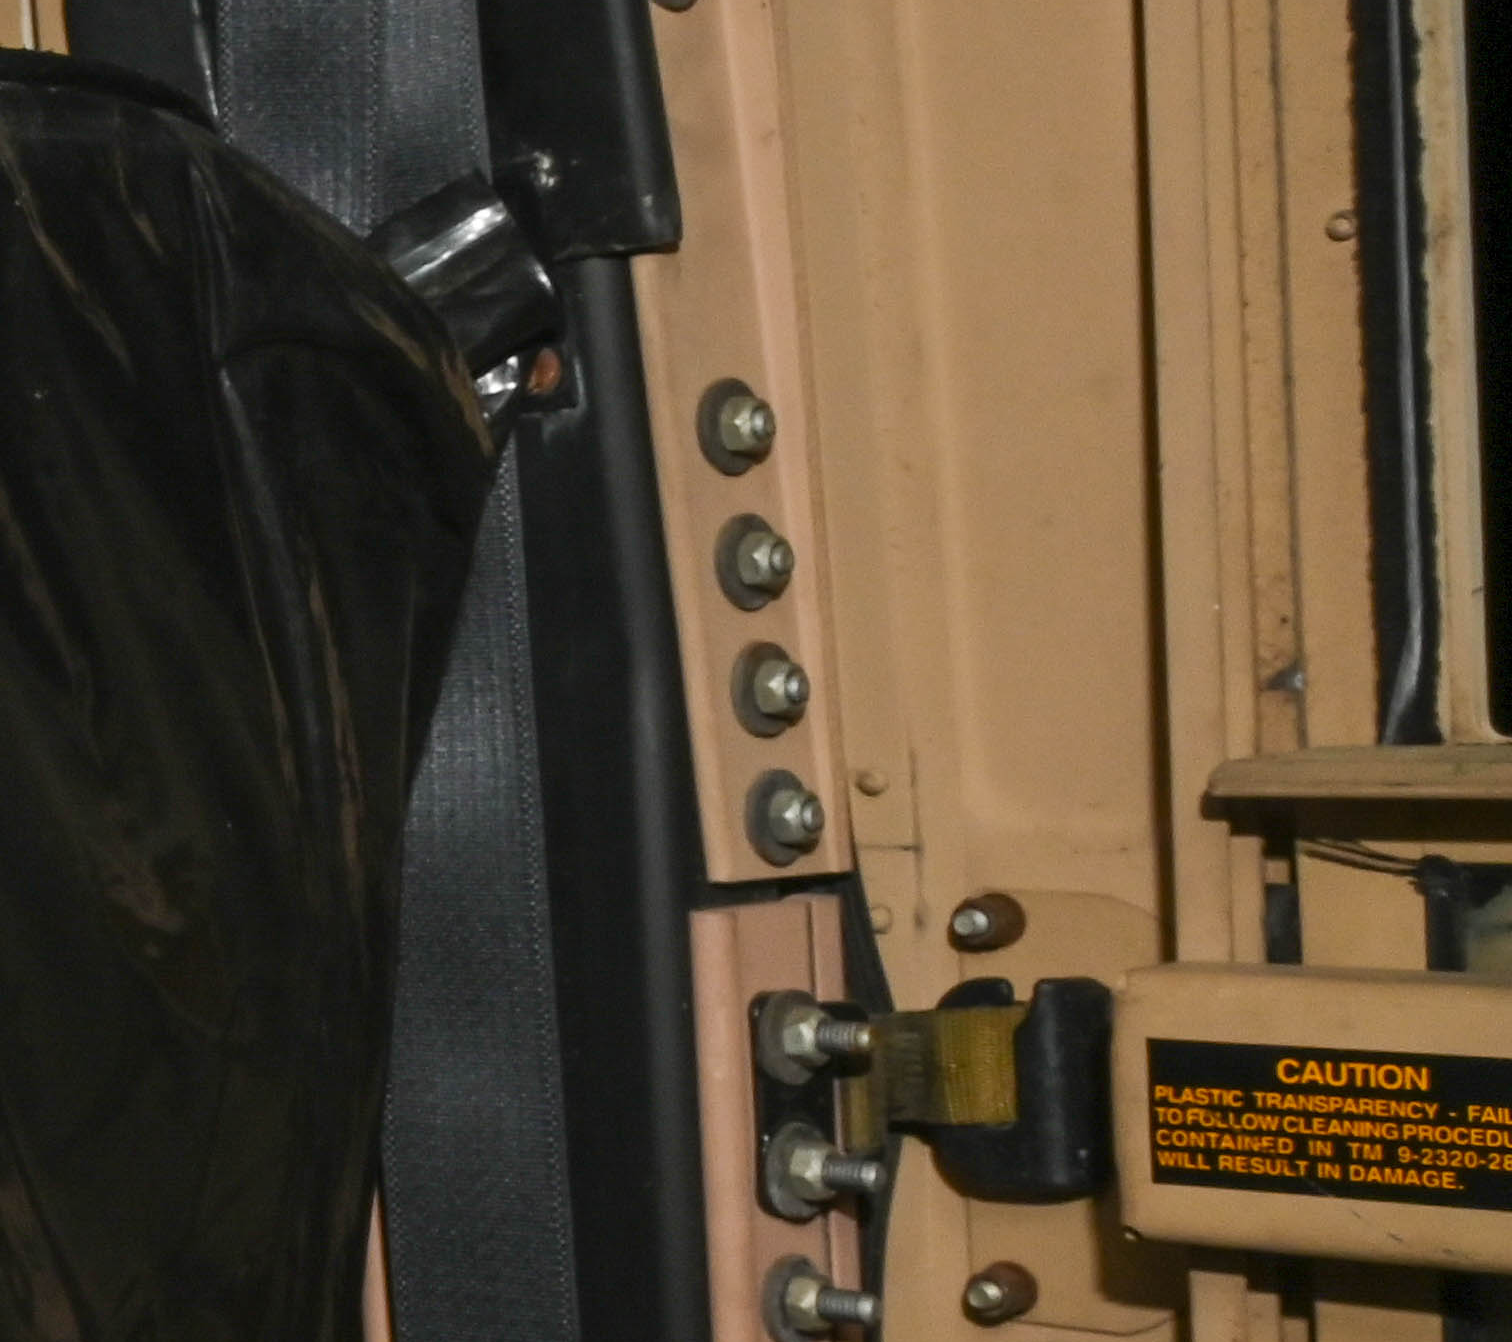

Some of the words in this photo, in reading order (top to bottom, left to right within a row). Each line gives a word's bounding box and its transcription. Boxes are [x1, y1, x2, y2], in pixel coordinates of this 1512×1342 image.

[1276, 1058, 1432, 1091] CAUTION
[1154, 1086, 1245, 1107] PLASTIC
[1253, 1091, 1439, 1121] TRANSPARENCY
[1156, 1107, 1184, 1125] TO
[1187, 1109, 1280, 1133] FOLLOW
[1282, 1117, 1399, 1141] CLEANING
[1156, 1130, 1294, 1156] CONTAINED
[1308, 1140, 1334, 1157] IN
[1348, 1143, 1384, 1161] TM
[1157, 1151, 1210, 1170] WILL
[1218, 1155, 1309, 1177] RESULT
[1317, 1162, 1341, 1180] IN
[1350, 1165, 1464, 1191] DAMAGE.
